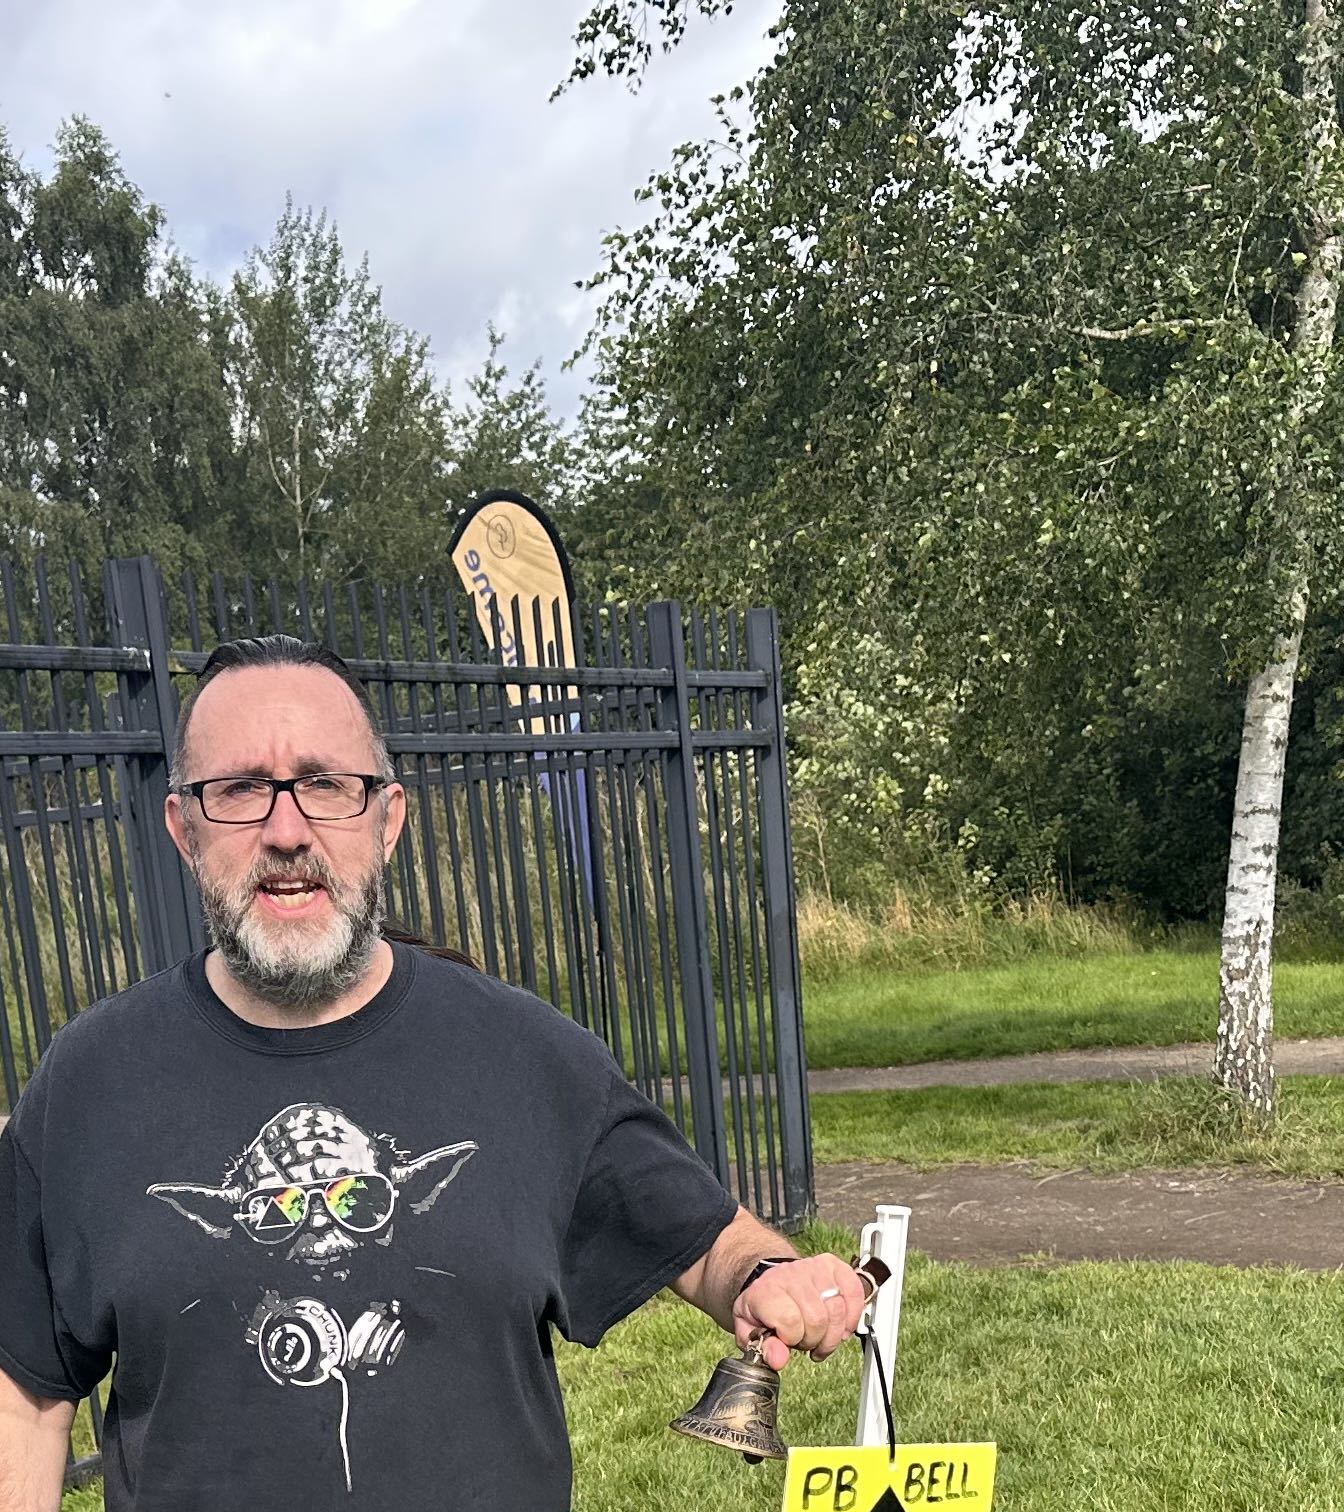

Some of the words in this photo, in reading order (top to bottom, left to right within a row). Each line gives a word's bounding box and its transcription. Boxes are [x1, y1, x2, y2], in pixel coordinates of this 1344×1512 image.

[308, 1305, 338, 1357] CHUNK
[801, 1464, 860, 1512] PB
[904, 1460, 980, 1505] BELL
